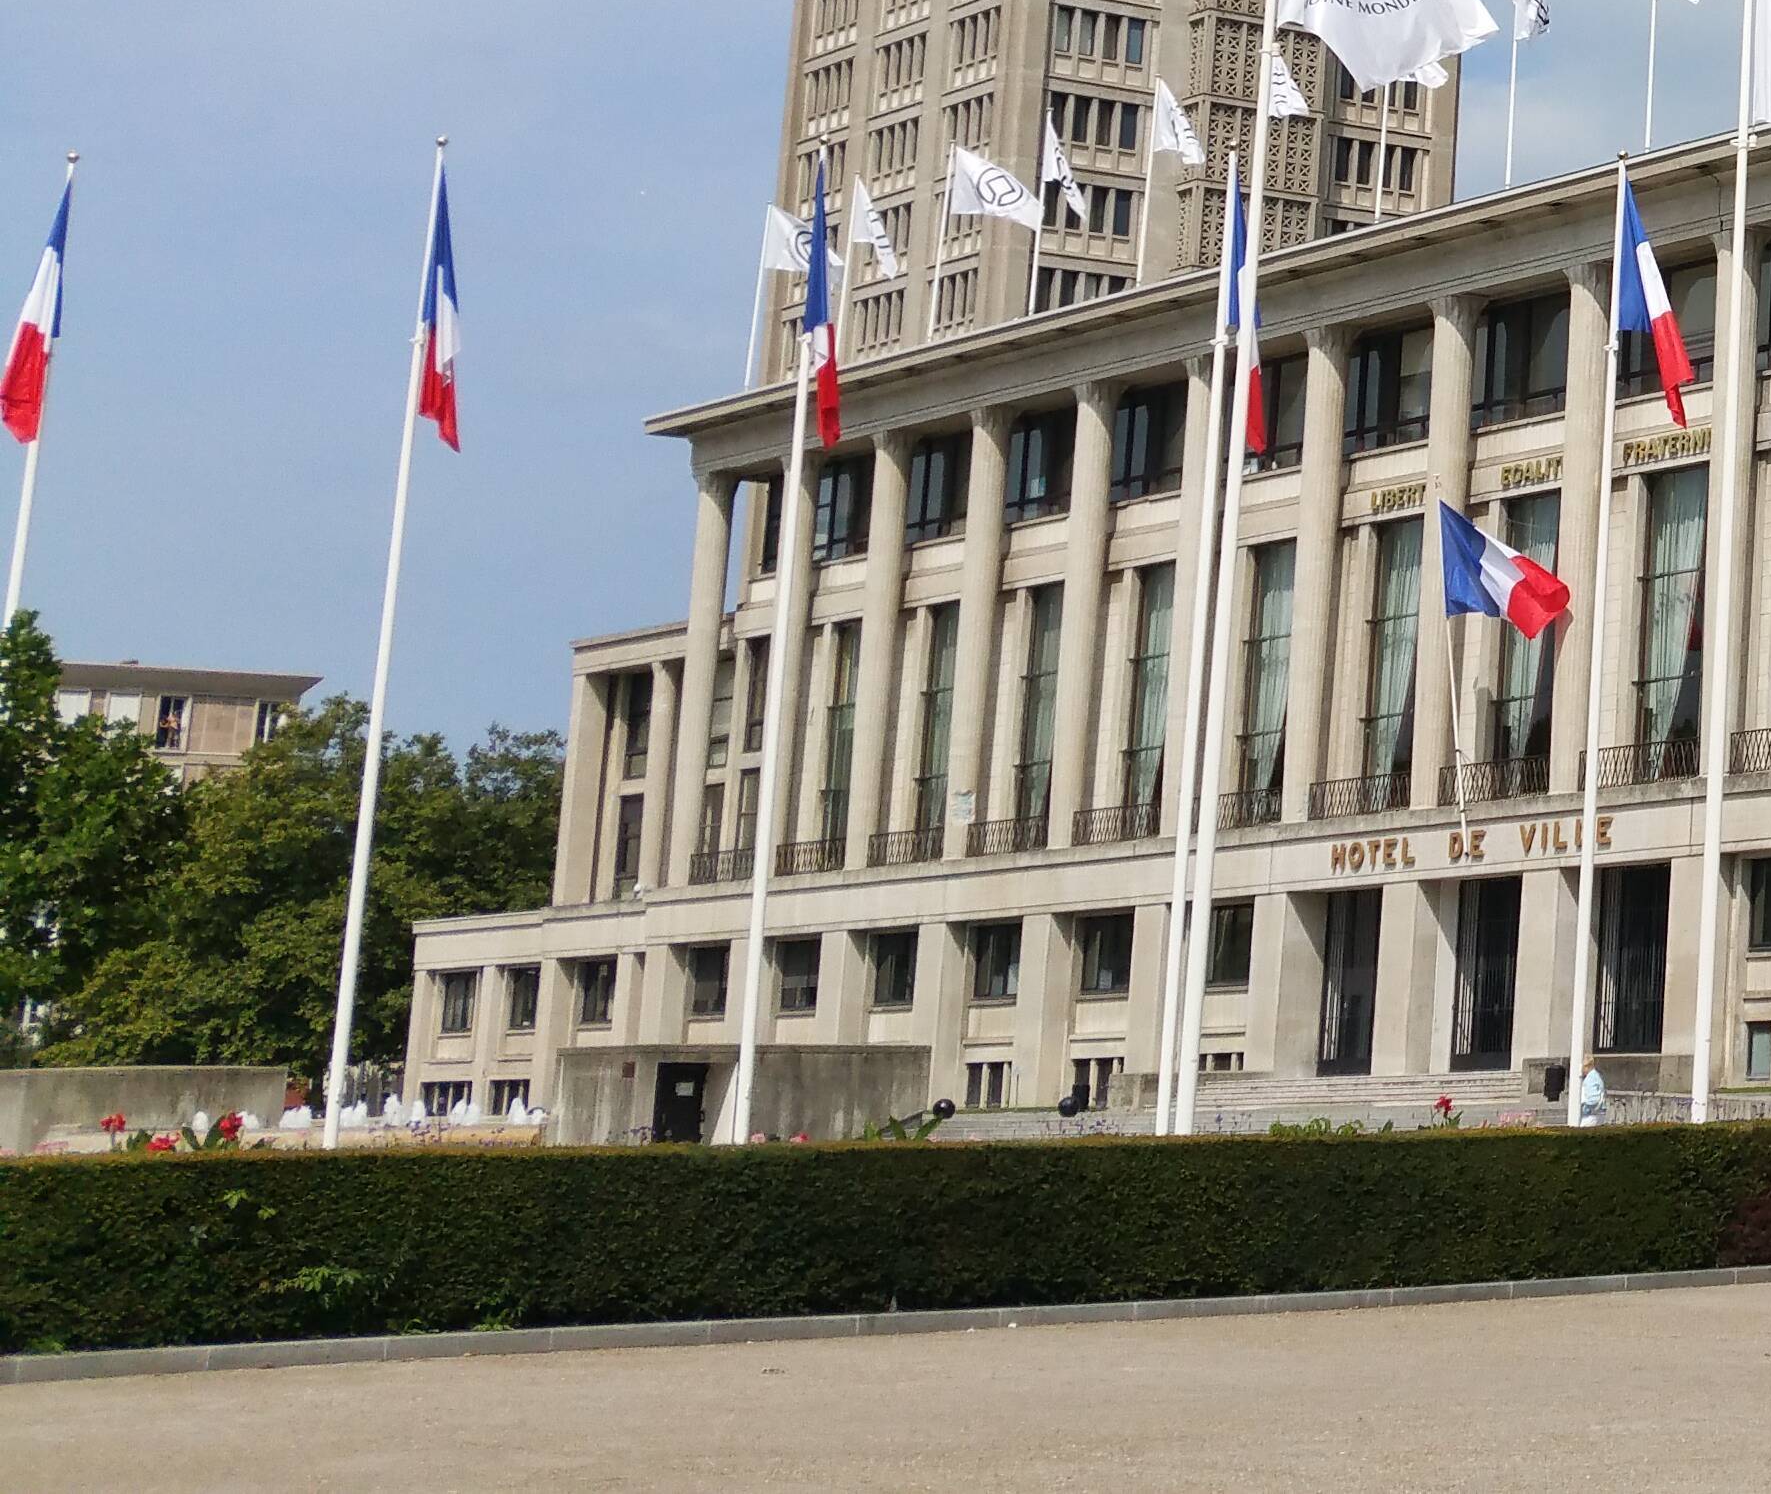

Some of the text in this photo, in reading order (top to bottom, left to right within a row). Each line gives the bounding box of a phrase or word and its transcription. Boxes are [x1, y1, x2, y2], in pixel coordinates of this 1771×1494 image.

[1371, 427, 1712, 511] LIBERT EGALIT FRATERNI
[1331, 816, 1615, 874] HOTEL DE VILLE
